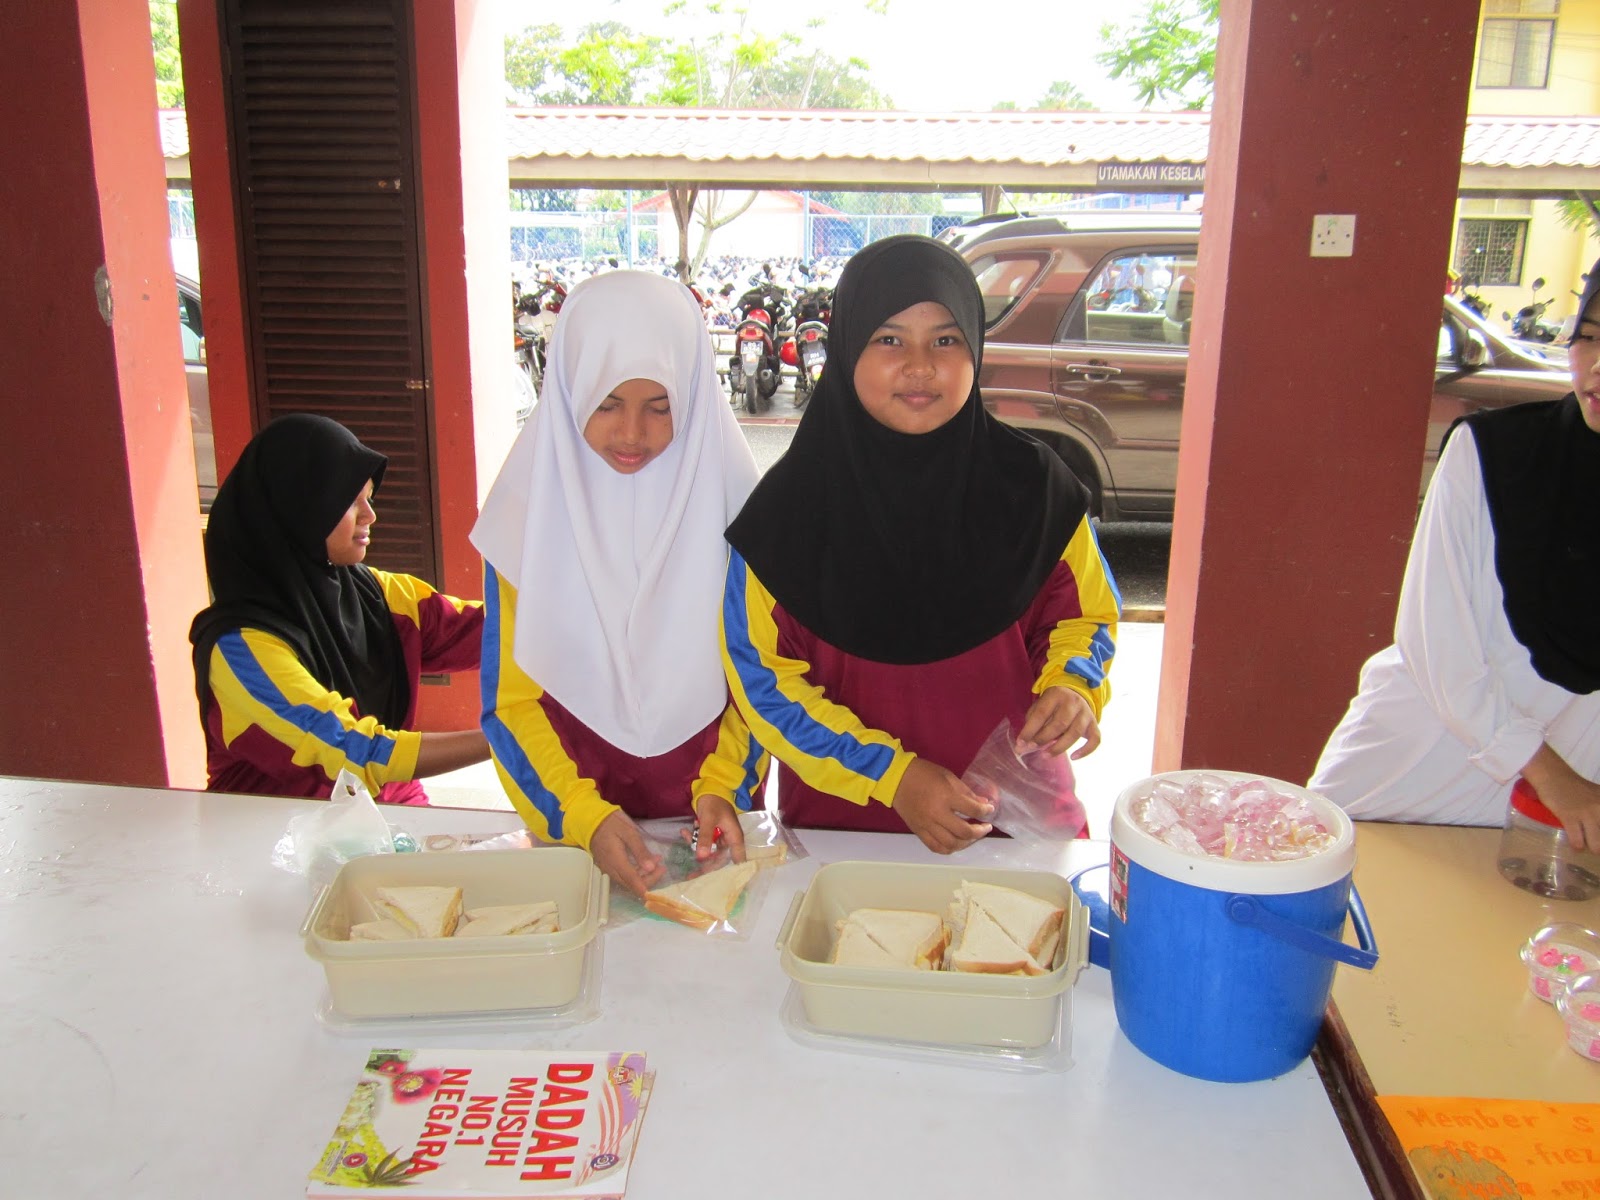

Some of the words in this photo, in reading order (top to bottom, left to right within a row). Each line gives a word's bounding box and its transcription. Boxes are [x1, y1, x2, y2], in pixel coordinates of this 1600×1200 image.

[1098, 165, 1158, 181] UTAMAKAN
[404, 1068, 473, 1175] NEGARA
[454, 1095, 499, 1145] NO.1
[484, 1077, 539, 1166] MUSUH
[521, 1063, 595, 1181] DADAH
